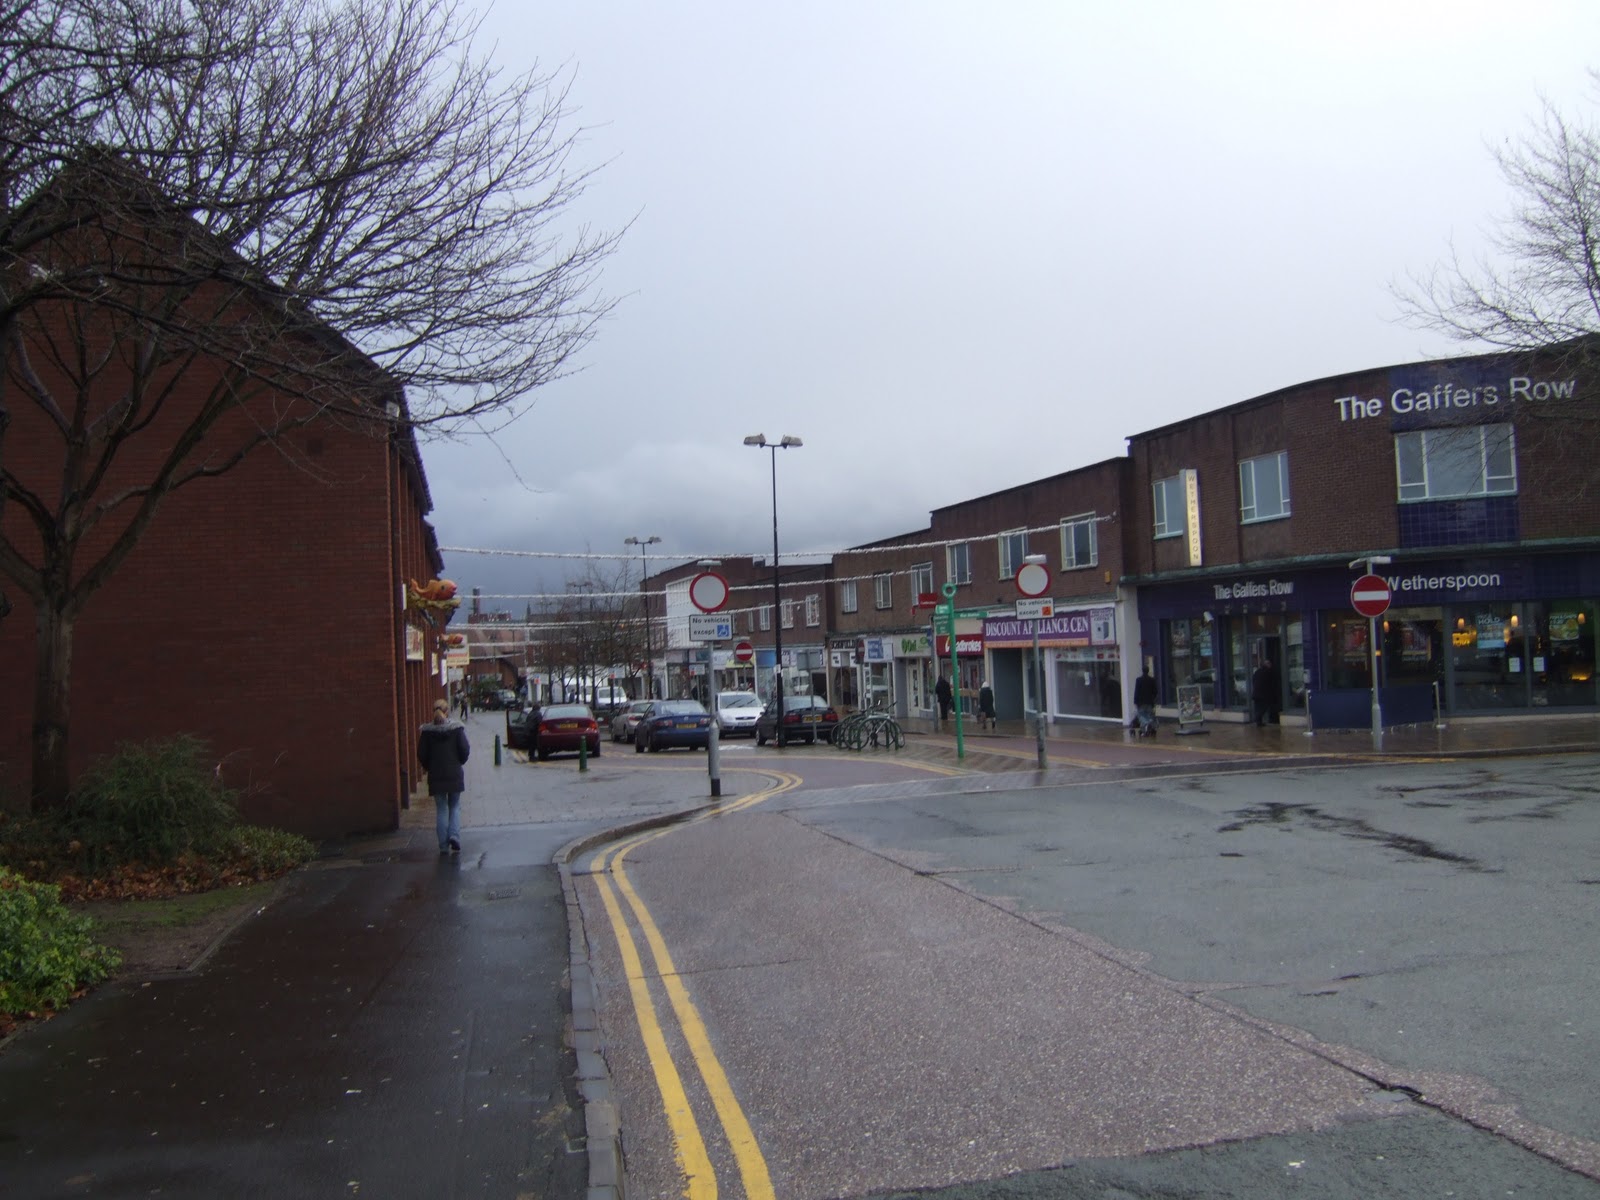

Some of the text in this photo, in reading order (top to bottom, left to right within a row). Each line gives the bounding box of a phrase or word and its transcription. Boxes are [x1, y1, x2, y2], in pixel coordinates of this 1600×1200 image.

[1334, 377, 1576, 422] The Gaffers Row
[1187, 475, 1199, 560] WETHERSPOON
[1213, 579, 1294, 600] The Gaffers Row
[985, 621, 1021, 637] DISCOUNT
[1022, 618, 1069, 636] APLIANCE
